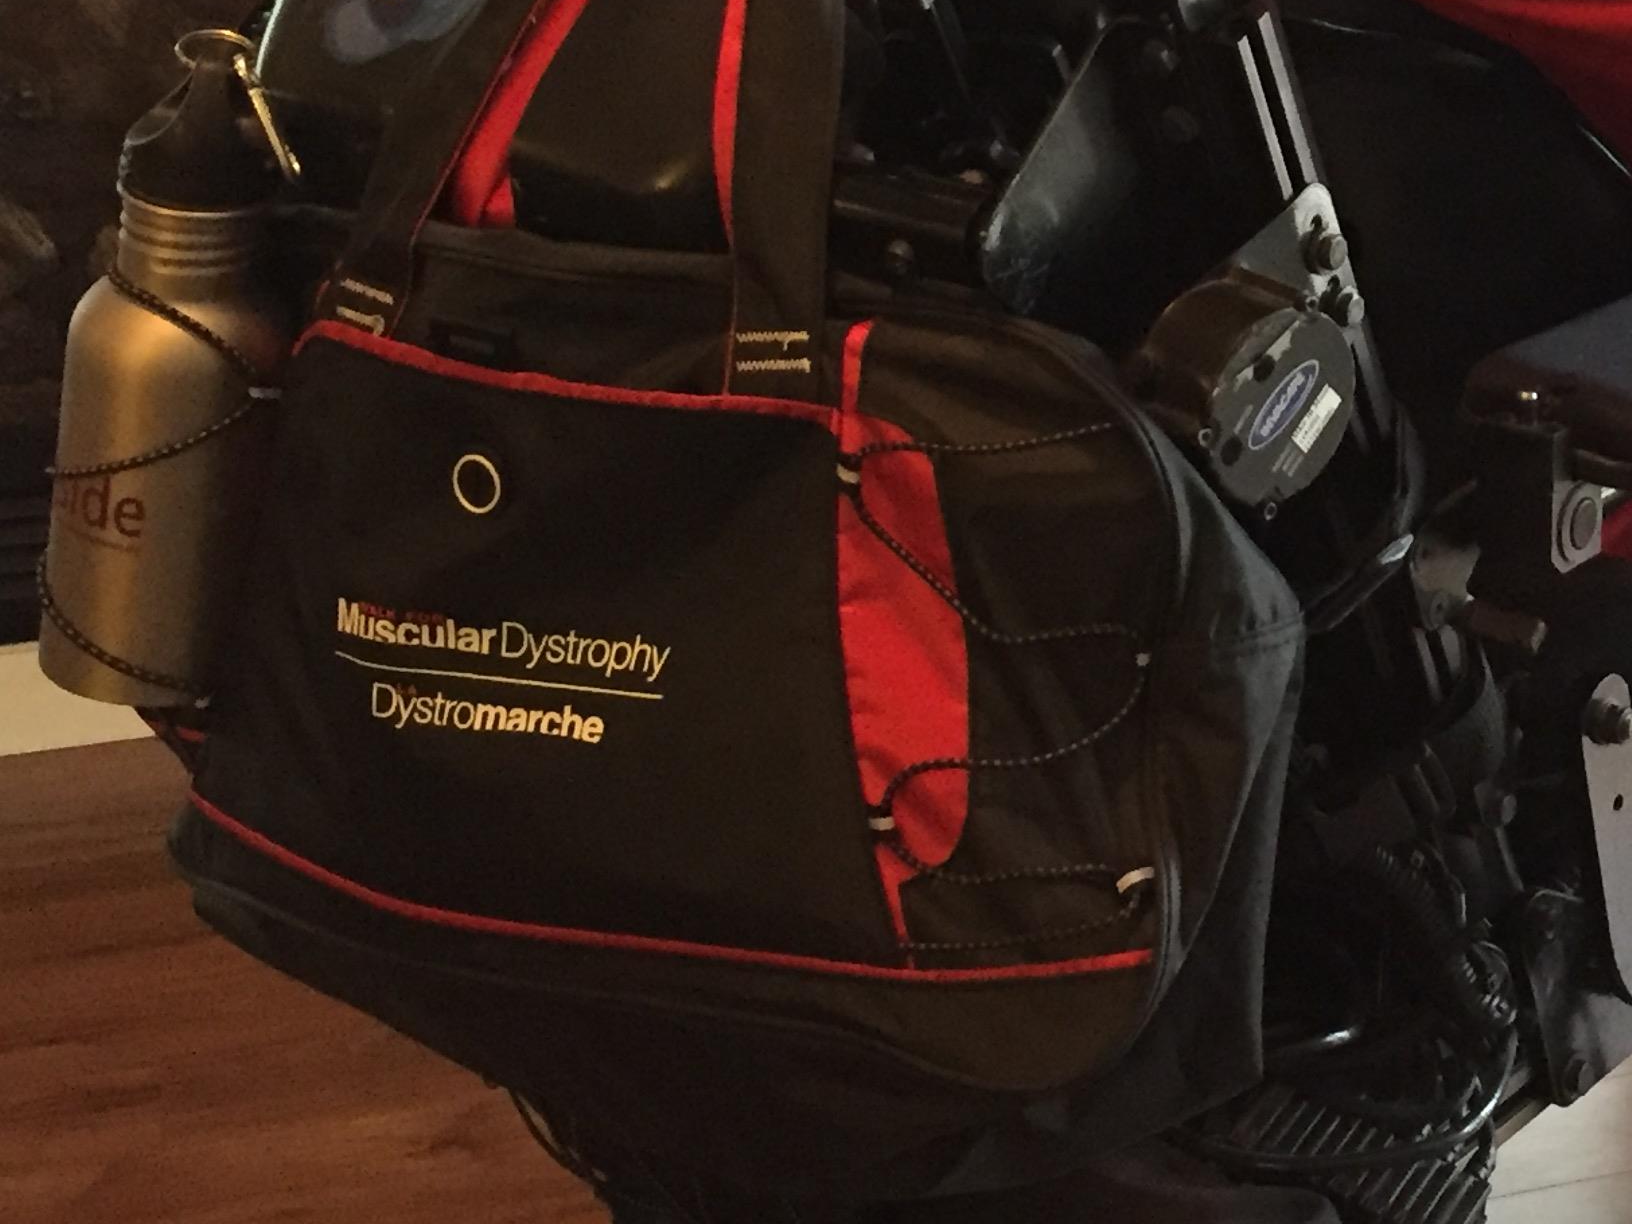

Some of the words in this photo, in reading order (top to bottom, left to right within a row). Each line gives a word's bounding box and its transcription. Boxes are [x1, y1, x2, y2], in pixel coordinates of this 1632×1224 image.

[336, 596, 497, 656] Muscular
[500, 620, 672, 683] Dystrophy
[371, 681, 605, 745] Dystromarche
